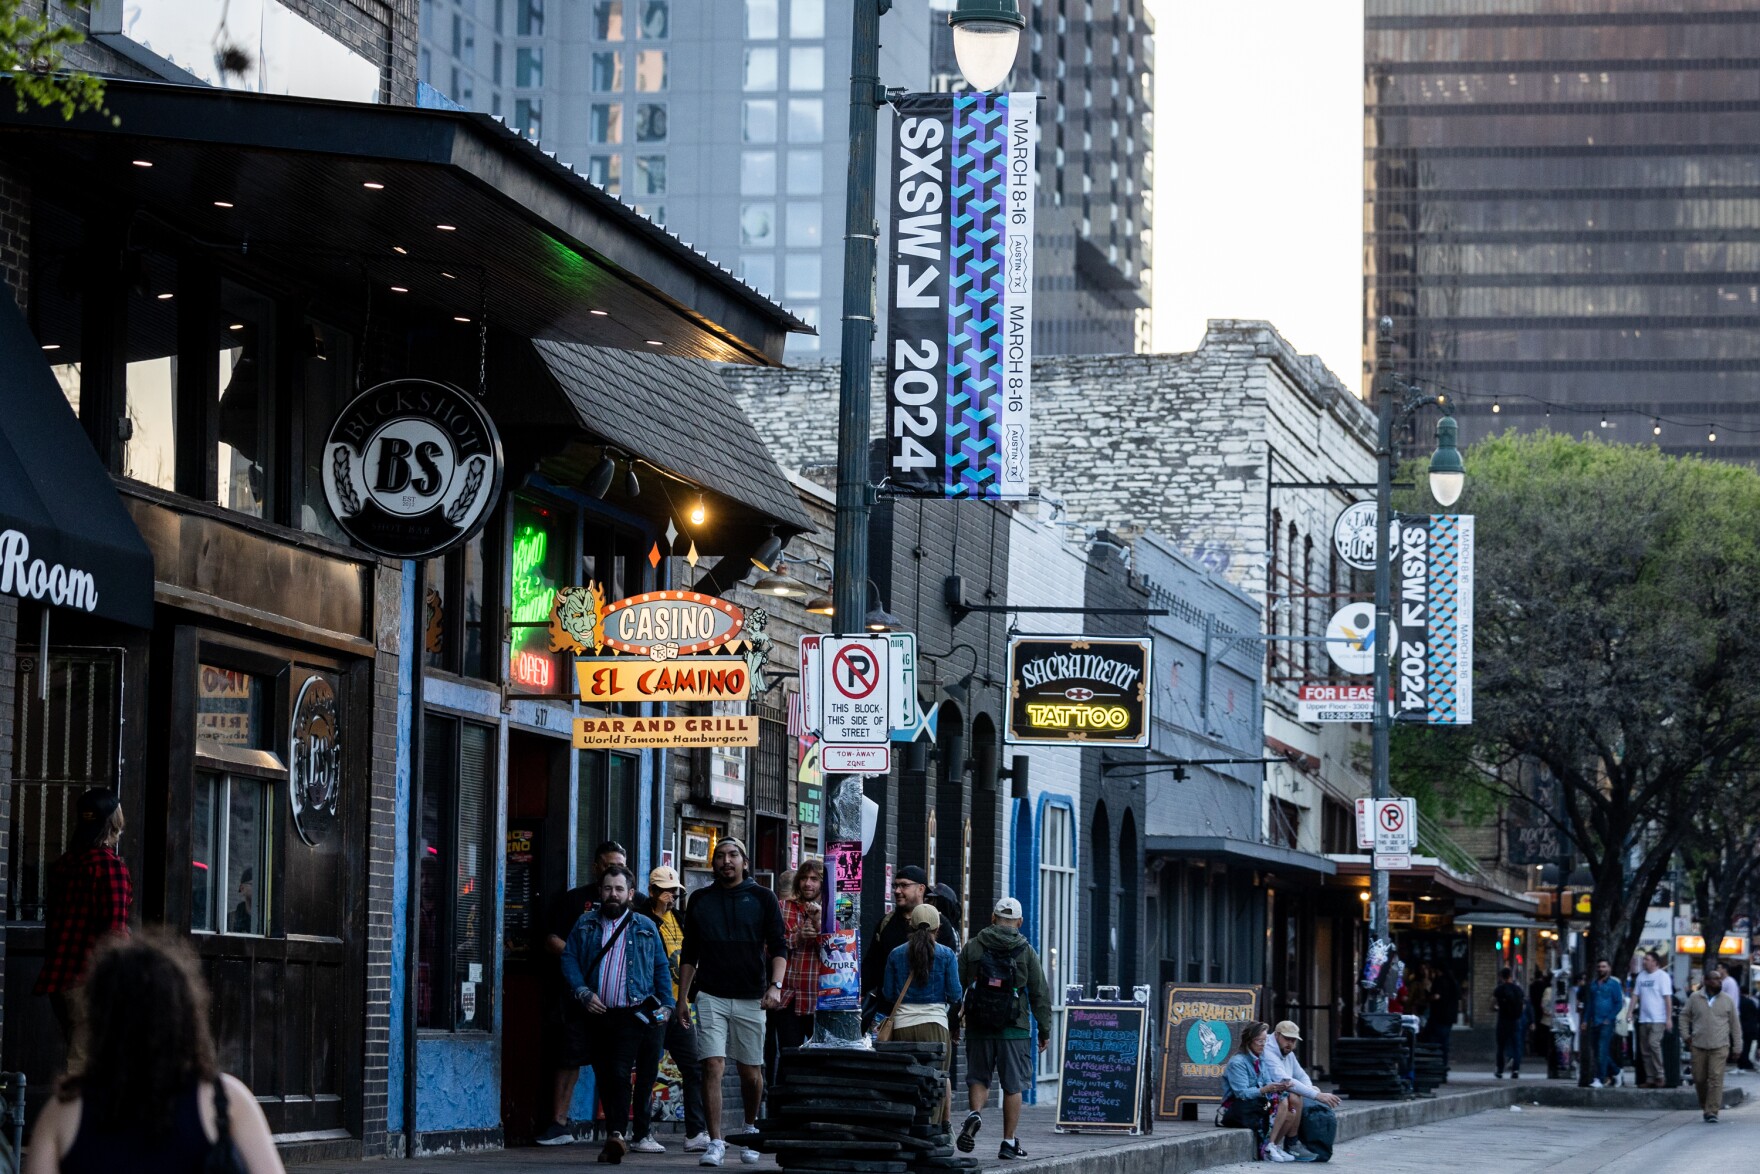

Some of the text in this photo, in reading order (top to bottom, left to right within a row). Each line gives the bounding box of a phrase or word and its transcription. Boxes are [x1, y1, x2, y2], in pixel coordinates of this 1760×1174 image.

[1012, 119, 1028, 225] MARCH 8-16
[1014, 277, 1021, 288] TX
[893, 117, 944, 472] SXSW 2024
[1008, 306, 1024, 412] MARCH 8-16
[344, 391, 481, 450] BUCKSHOT
[373, 437, 445, 497] BS
[1011, 466, 1018, 476] TX
[1354, 511, 1377, 527] TW
[1342, 541, 1377, 560] BUC
[1461, 529, 1470, 566] MARCH
[0, 529, 98, 612] Room
[619, 606, 715, 641] CASINO
[1401, 527, 1427, 710] SXSW 2024
[1461, 624, 1469, 660] MARCH
[519, 652, 549, 686] OPEN
[1022, 651, 1140, 691] SACRAMENT
[591, 666, 745, 696] EL CAMINO
[1306, 688, 1374, 699] FOR LEAS
[535, 707, 548, 726] 517
[832, 704, 880, 713] THIS BLOCK
[1027, 704, 1129, 728] TATTOO
[1306, 703, 1327, 711] Upper
[583, 719, 748, 733] BAR AND GRILL
[828, 716, 884, 725] THIS SIDE OF
[583, 734, 748, 745] World Famous Hamburgers
[841, 728, 870, 737] STREET
[824, 959, 854, 969] FUTURE
[821, 972, 855, 988] NOW
